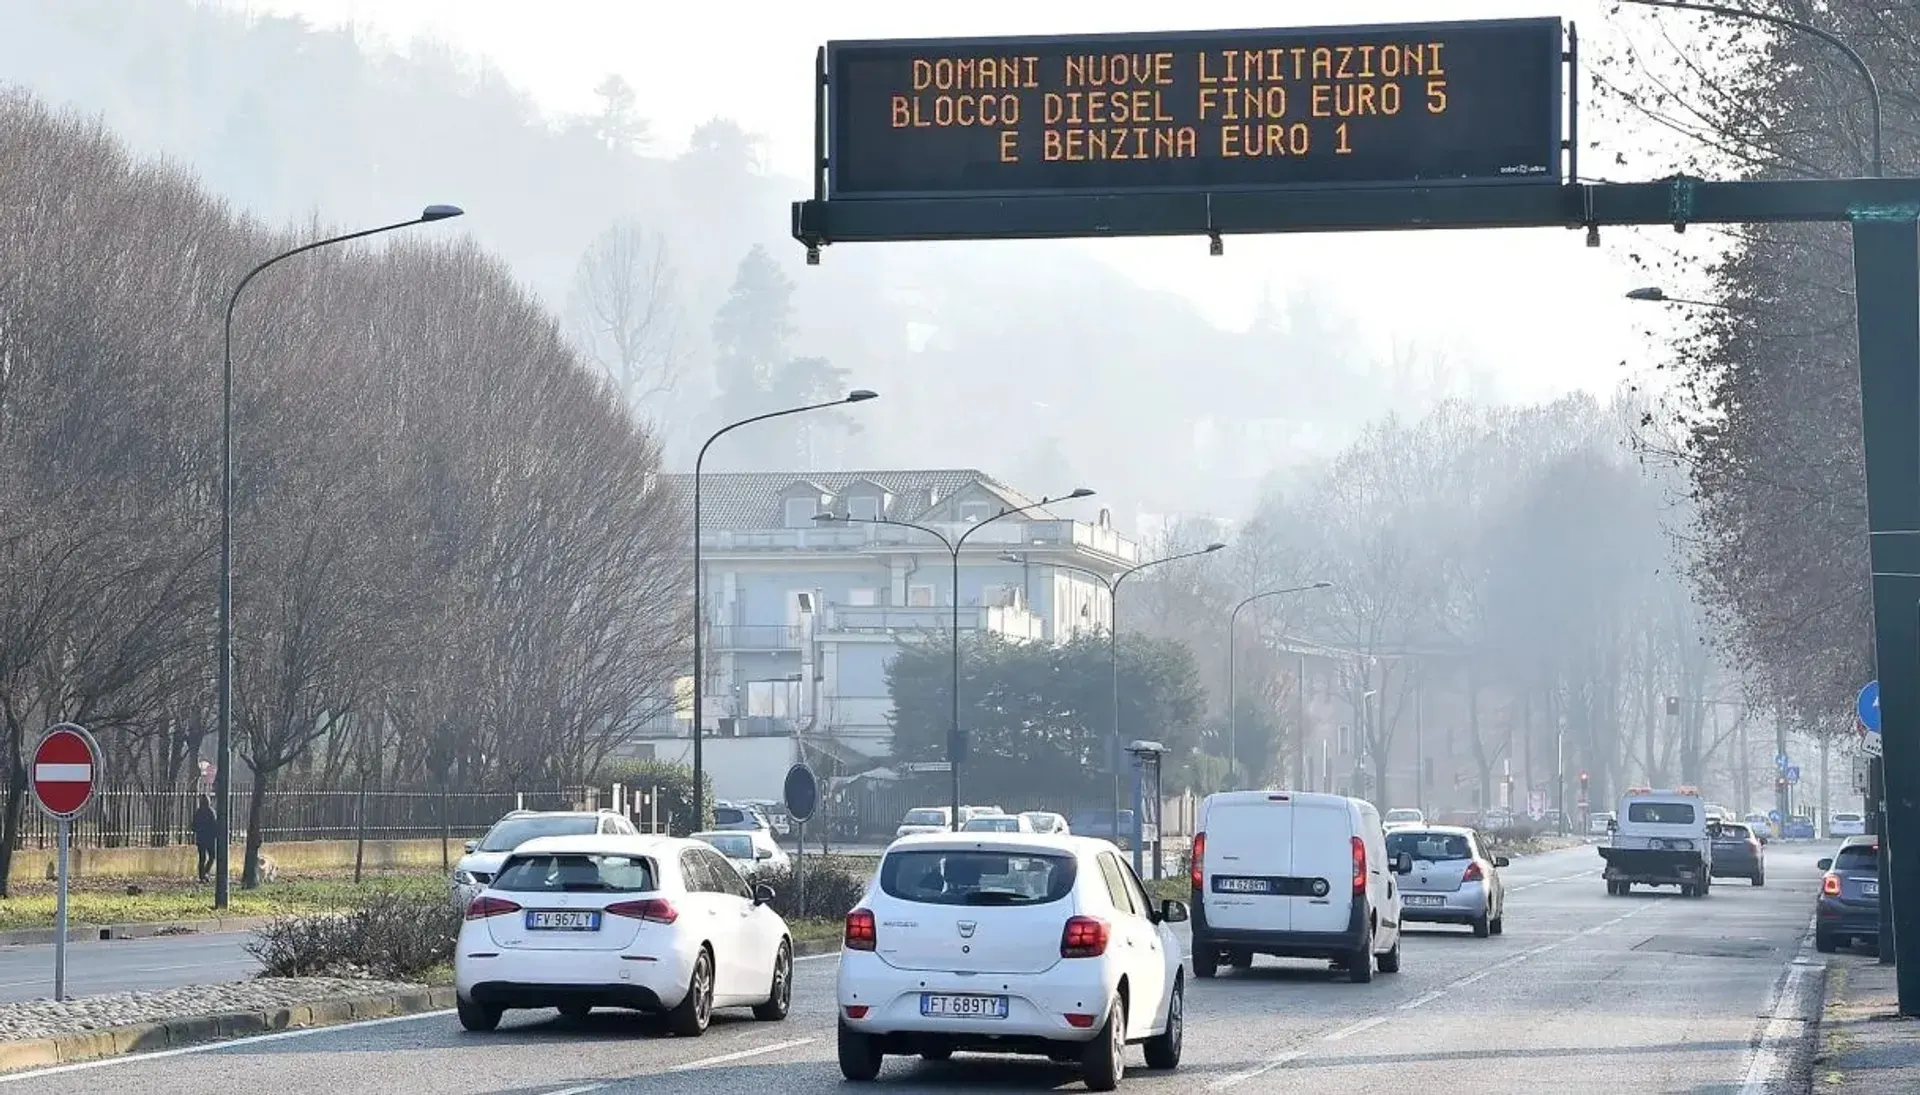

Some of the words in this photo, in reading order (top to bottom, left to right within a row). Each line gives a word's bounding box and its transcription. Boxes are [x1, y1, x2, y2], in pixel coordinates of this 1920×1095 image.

[913, 56, 1039, 90] DOMANI
[1065, 53, 1174, 86] NUOVE
[1199, 42, 1445, 83] LIMITAZIONI
[892, 94, 1019, 127] BLOCCO
[1044, 90, 1174, 124] DIESEL
[1199, 86, 1286, 119] FINO
[1311, 82, 1401, 117] EURO
[1427, 81, 1447, 113] 5
[1000, 130, 1019, 162] E
[1044, 126, 1196, 161] BENZINA
[1221, 123, 1310, 156] EURO
[1335, 122, 1351, 153] 1
[536, 913, 551, 926] FV
[555, 913, 591, 926] 967LY
[930, 997, 947, 1012] FT
[952, 998, 998, 1013] 689TY
